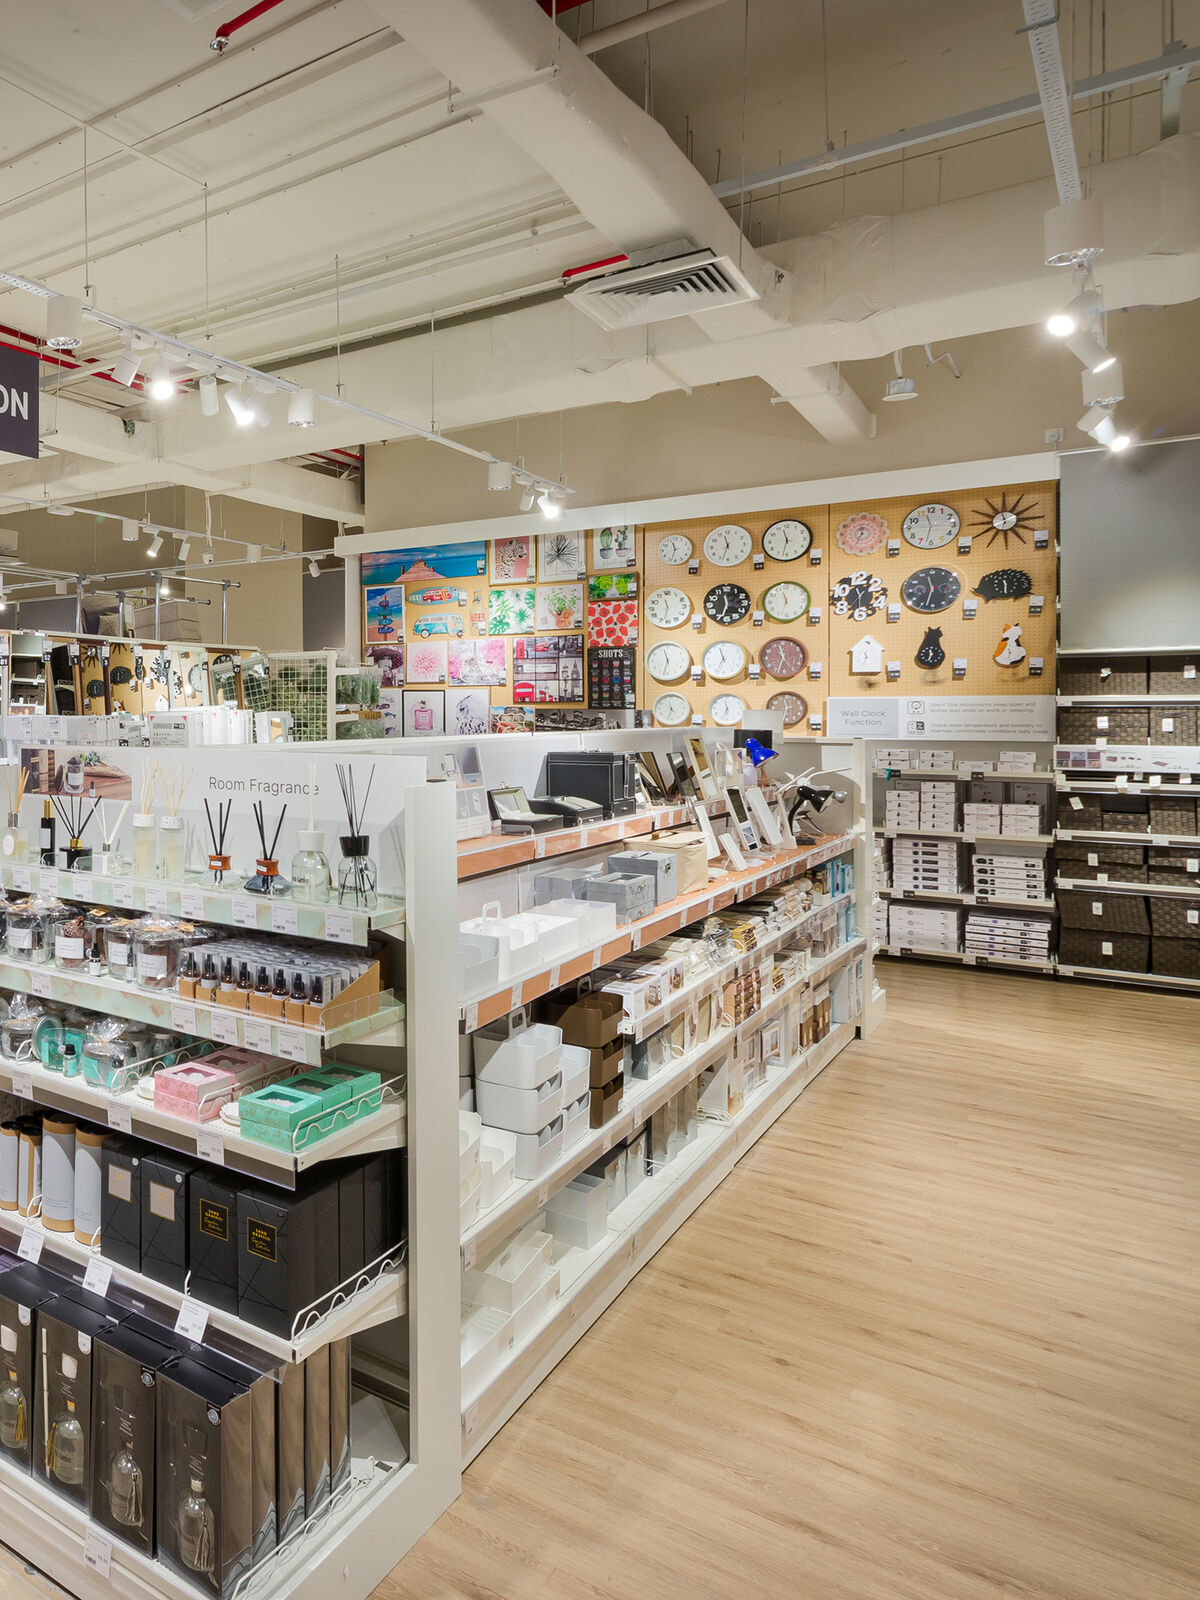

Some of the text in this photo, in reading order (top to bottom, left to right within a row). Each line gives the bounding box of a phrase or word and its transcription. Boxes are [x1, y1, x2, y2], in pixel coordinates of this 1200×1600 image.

[849, 571, 868, 585] 12
[868, 578, 882, 592] 2
[832, 584, 850, 598] 10
[835, 600, 848, 615] 8
[873, 595, 886, 609] 4
[854, 607, 867, 621] 6
[598, 649, 624, 658] SHOTS
[861, 709, 886, 717] Clock
[209, 776, 319, 796] Room Fragrance
